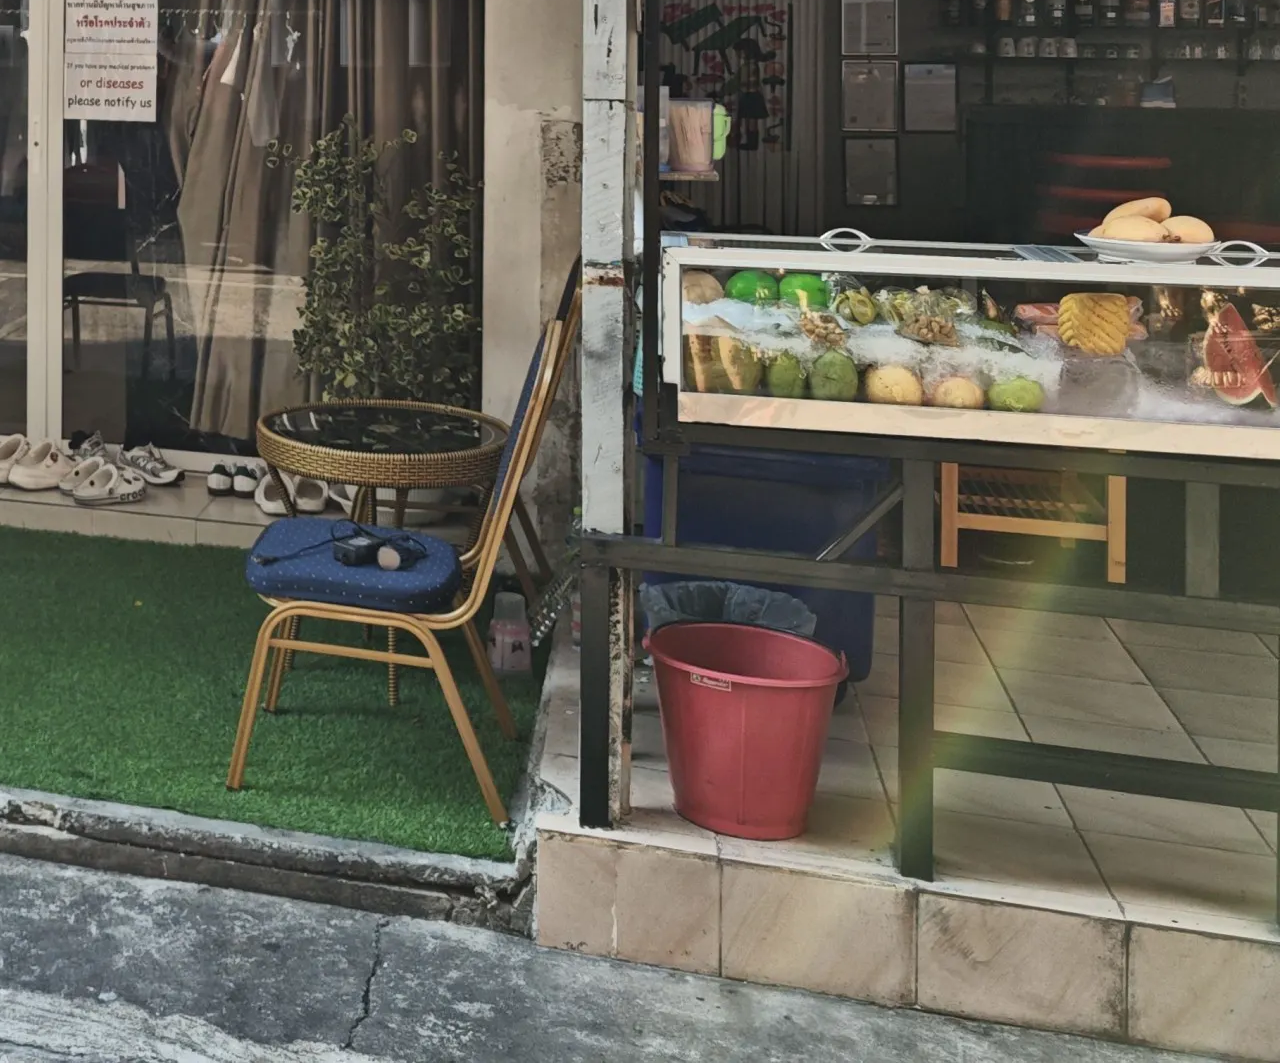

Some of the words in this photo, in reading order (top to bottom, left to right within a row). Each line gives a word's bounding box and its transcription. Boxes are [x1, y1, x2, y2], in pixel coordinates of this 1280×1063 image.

[80, 79, 92, 88] or
[96, 78, 144, 89] diseases
[68, 95, 100, 108] please
[105, 97, 137, 109] notify
[140, 100, 152, 108] us
